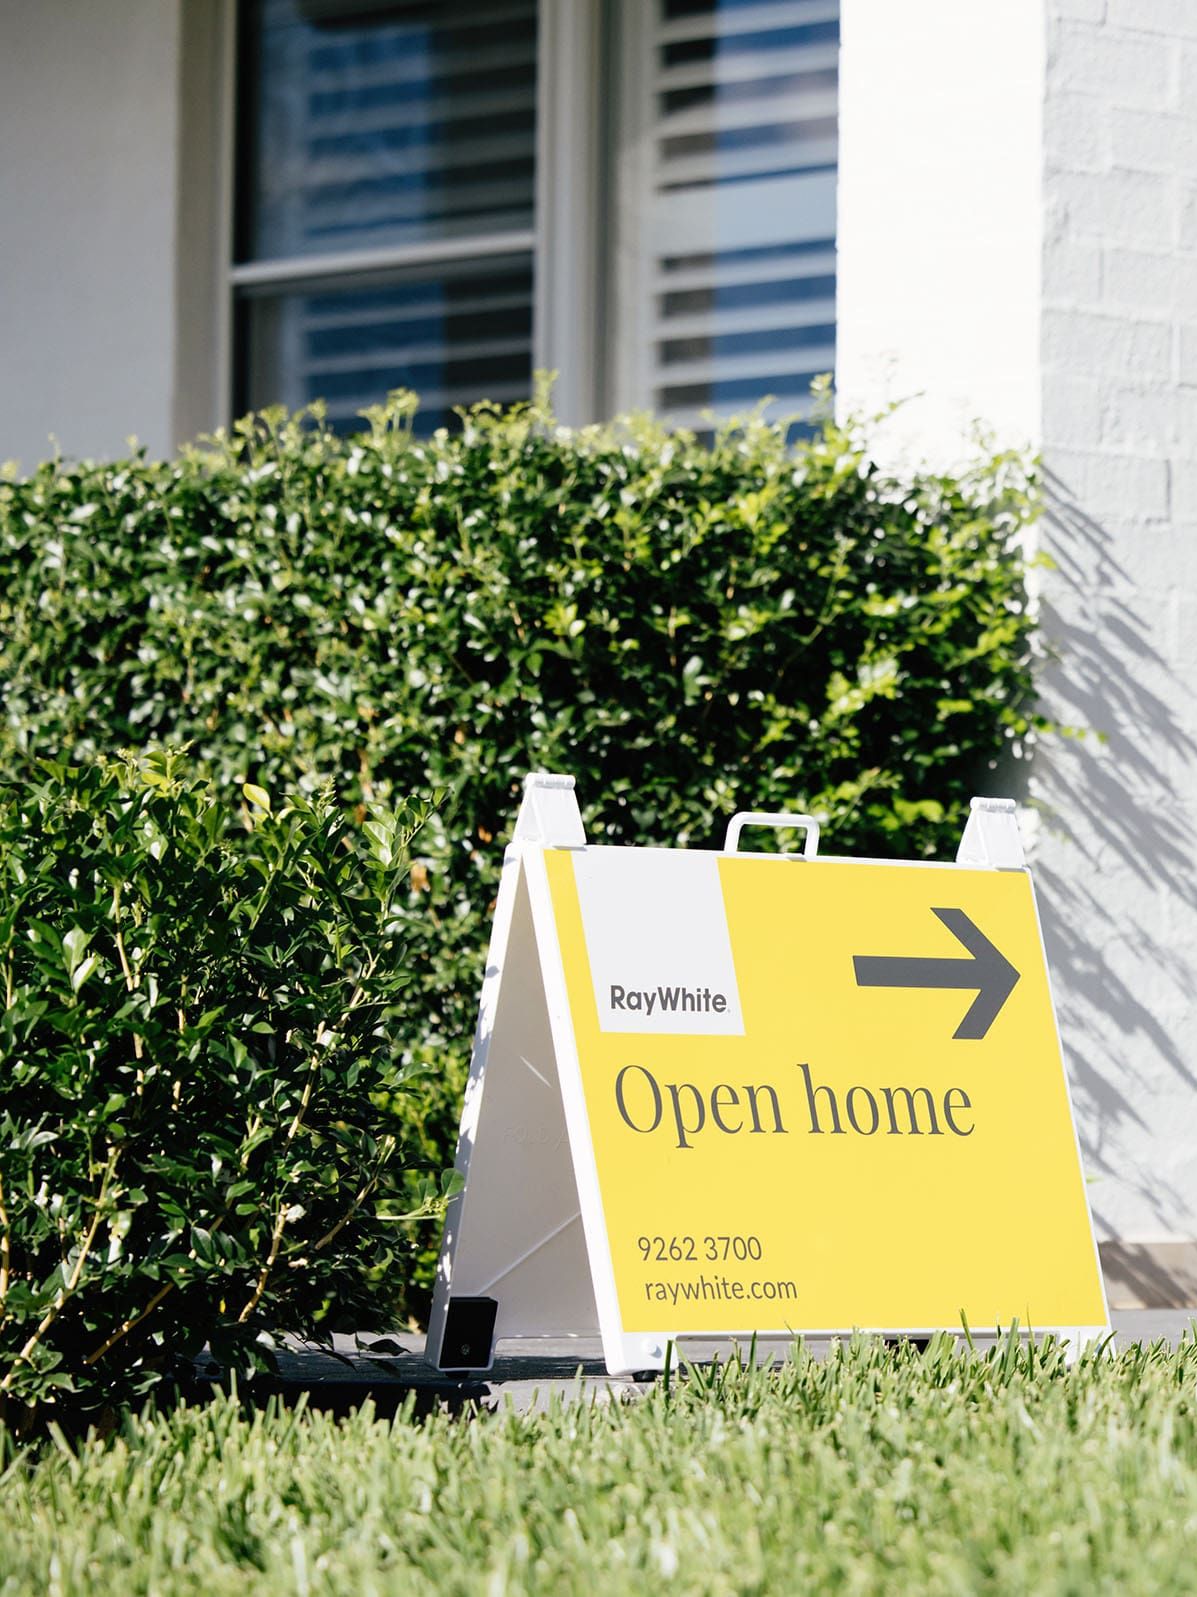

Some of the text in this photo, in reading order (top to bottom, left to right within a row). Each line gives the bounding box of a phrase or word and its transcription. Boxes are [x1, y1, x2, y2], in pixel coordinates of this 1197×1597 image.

[610, 984, 728, 1016] RayWhite
[614, 1063, 976, 1149] Open home
[637, 1236, 763, 1261] 9262 3700
[645, 1275, 798, 1306] raywhite.com
